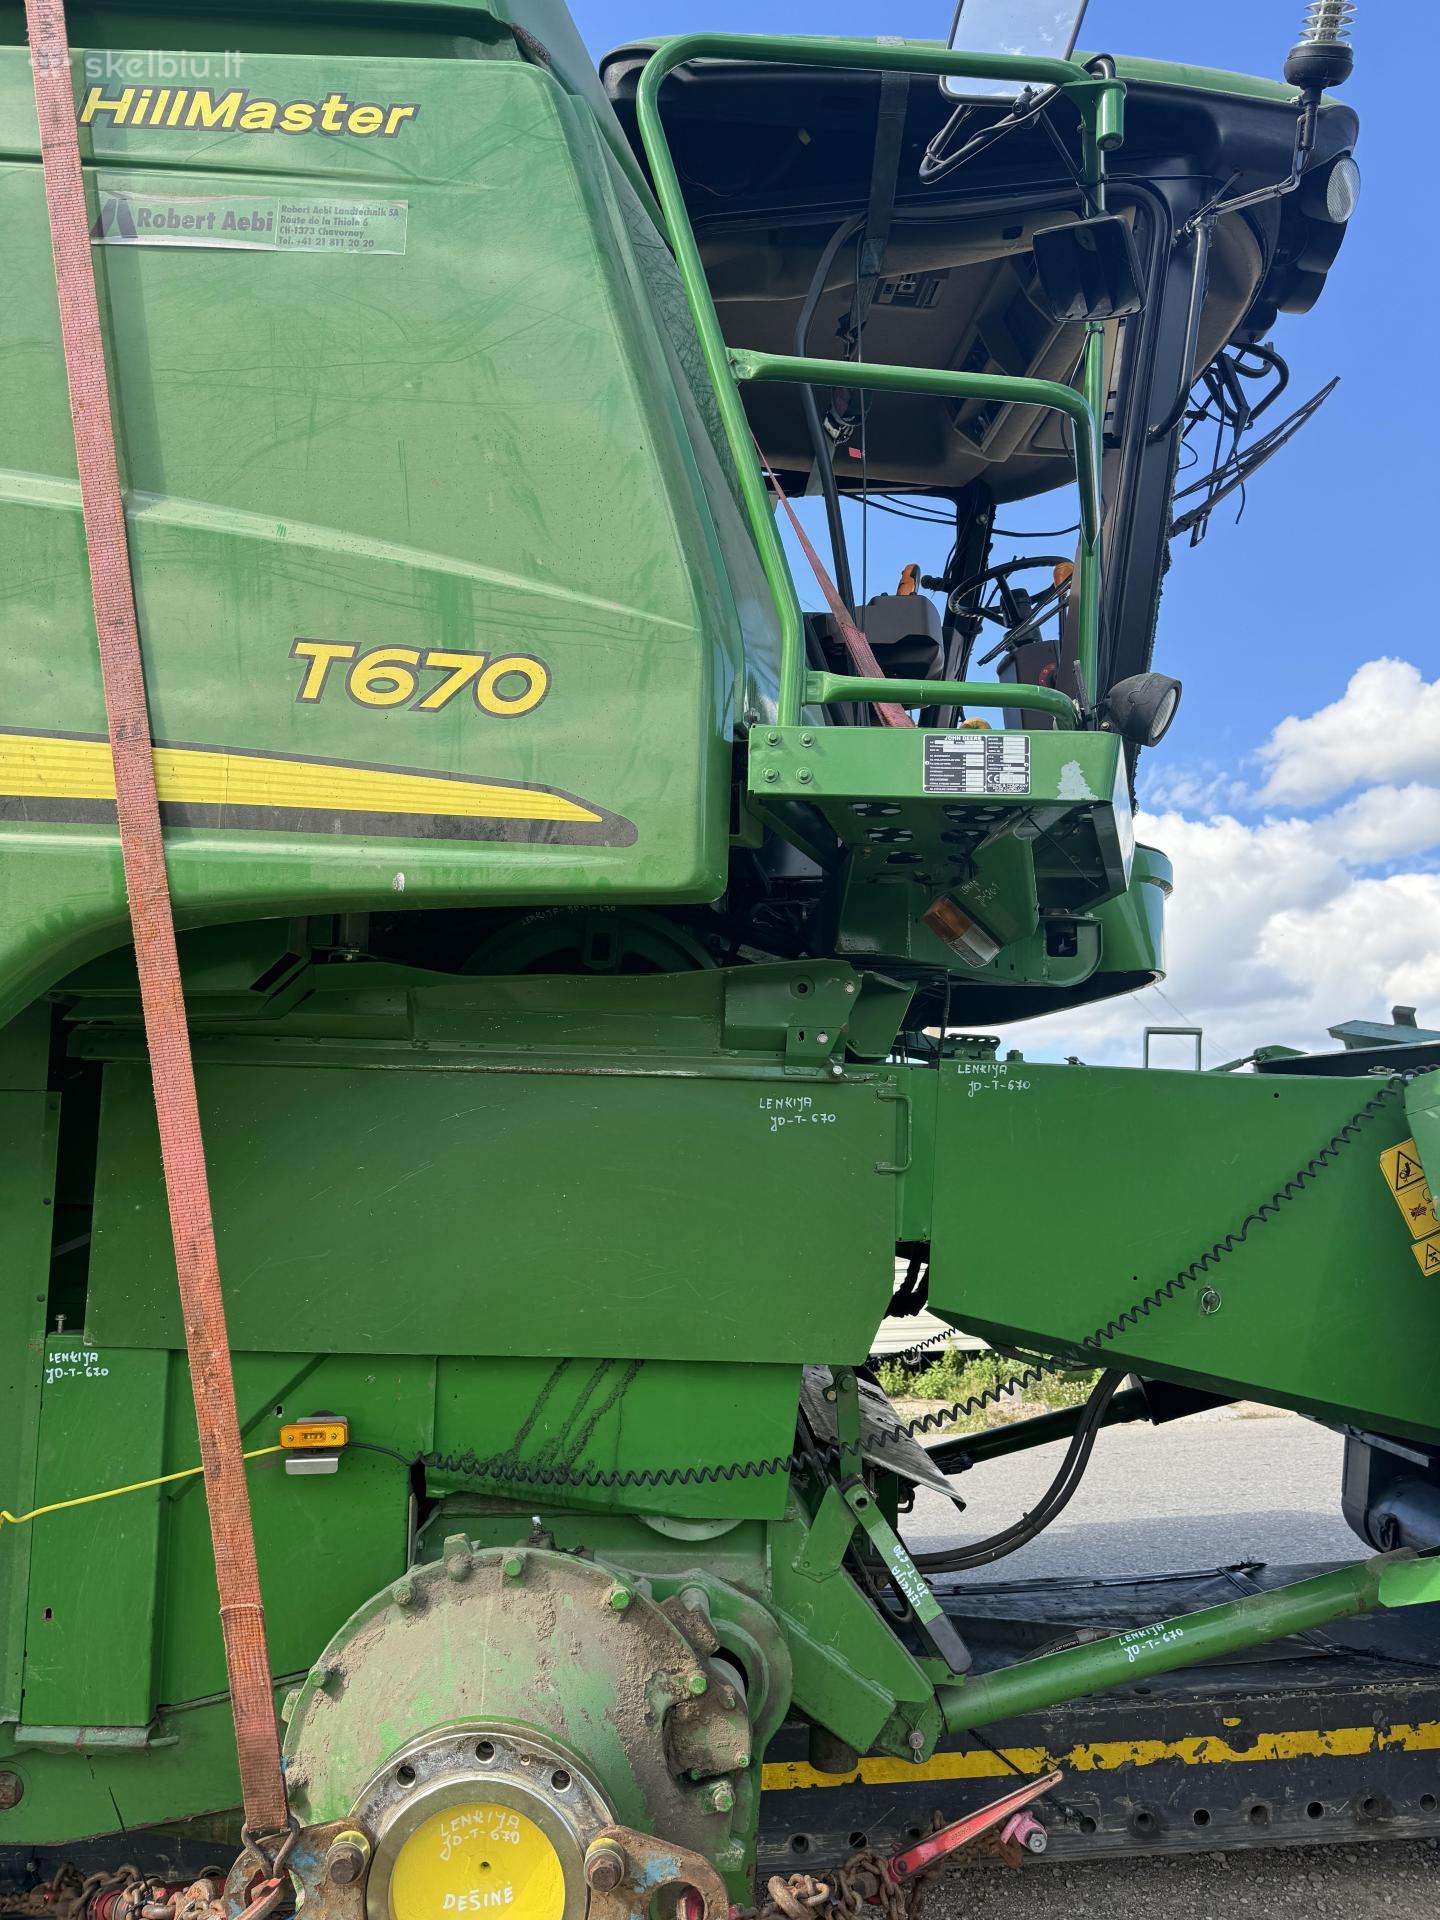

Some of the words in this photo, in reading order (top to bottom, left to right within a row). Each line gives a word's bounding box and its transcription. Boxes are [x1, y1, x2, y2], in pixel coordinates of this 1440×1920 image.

[78, 84, 419, 137] HillMaster
[137, 208, 215, 230] Robert
[221, 208, 274, 232] Aebi
[281, 205, 310, 214] Robert
[313, 206, 332, 215] Aebi
[363, 239, 374, 247] 20
[288, 638, 552, 719] T670
